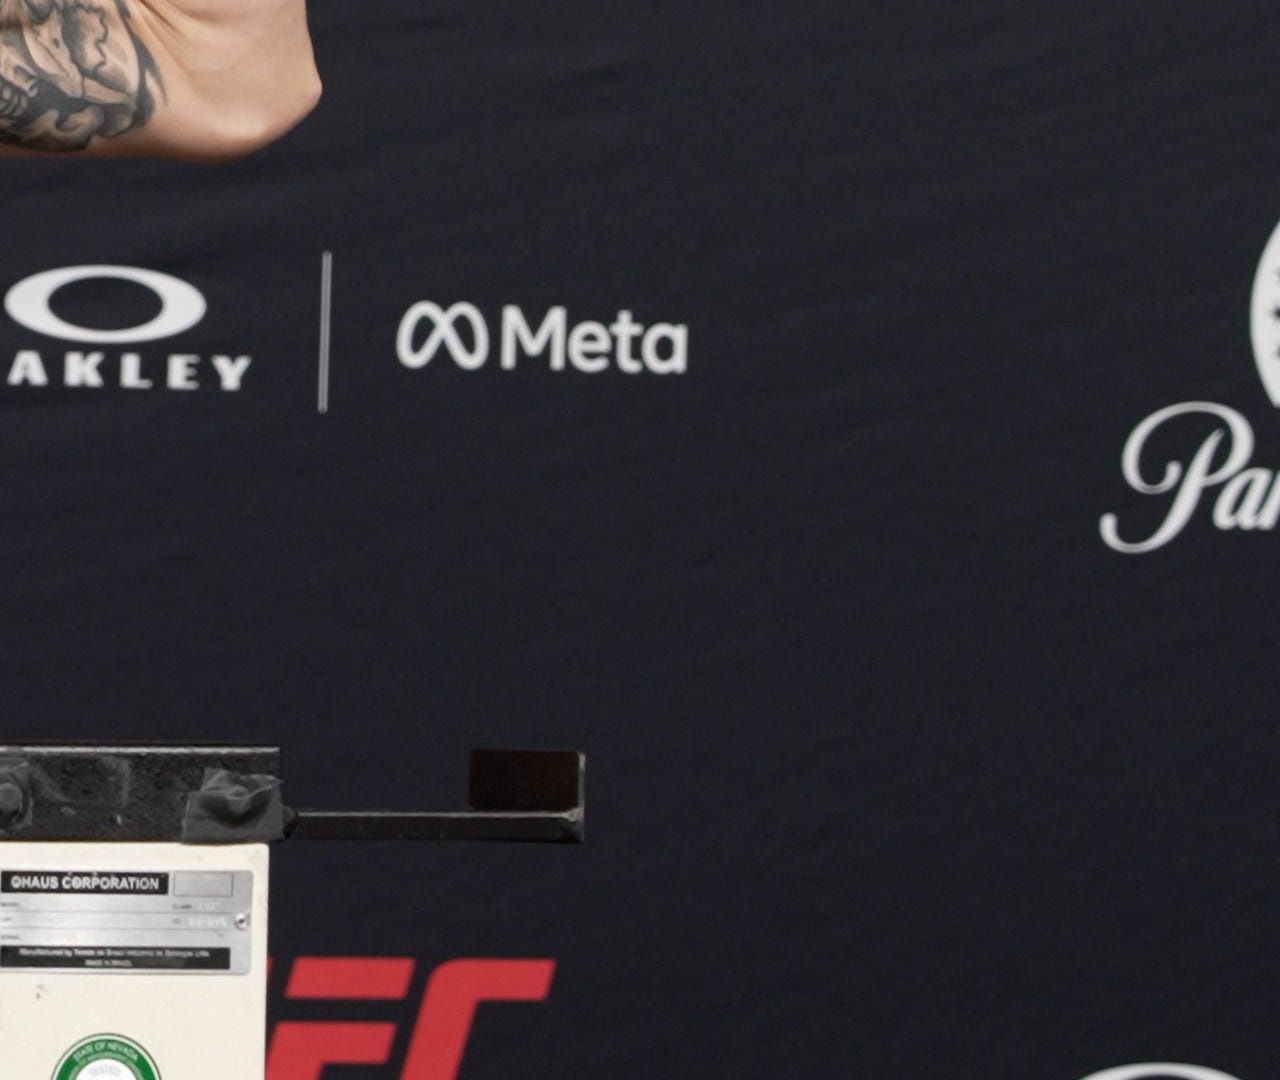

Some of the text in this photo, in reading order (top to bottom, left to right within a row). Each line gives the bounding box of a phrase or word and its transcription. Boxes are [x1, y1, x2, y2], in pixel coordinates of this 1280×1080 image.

[500, 305, 688, 374] Meta
[10, 875, 159, 891] OHAUS CORPORATION
[266, 956, 557, 1080] FC
